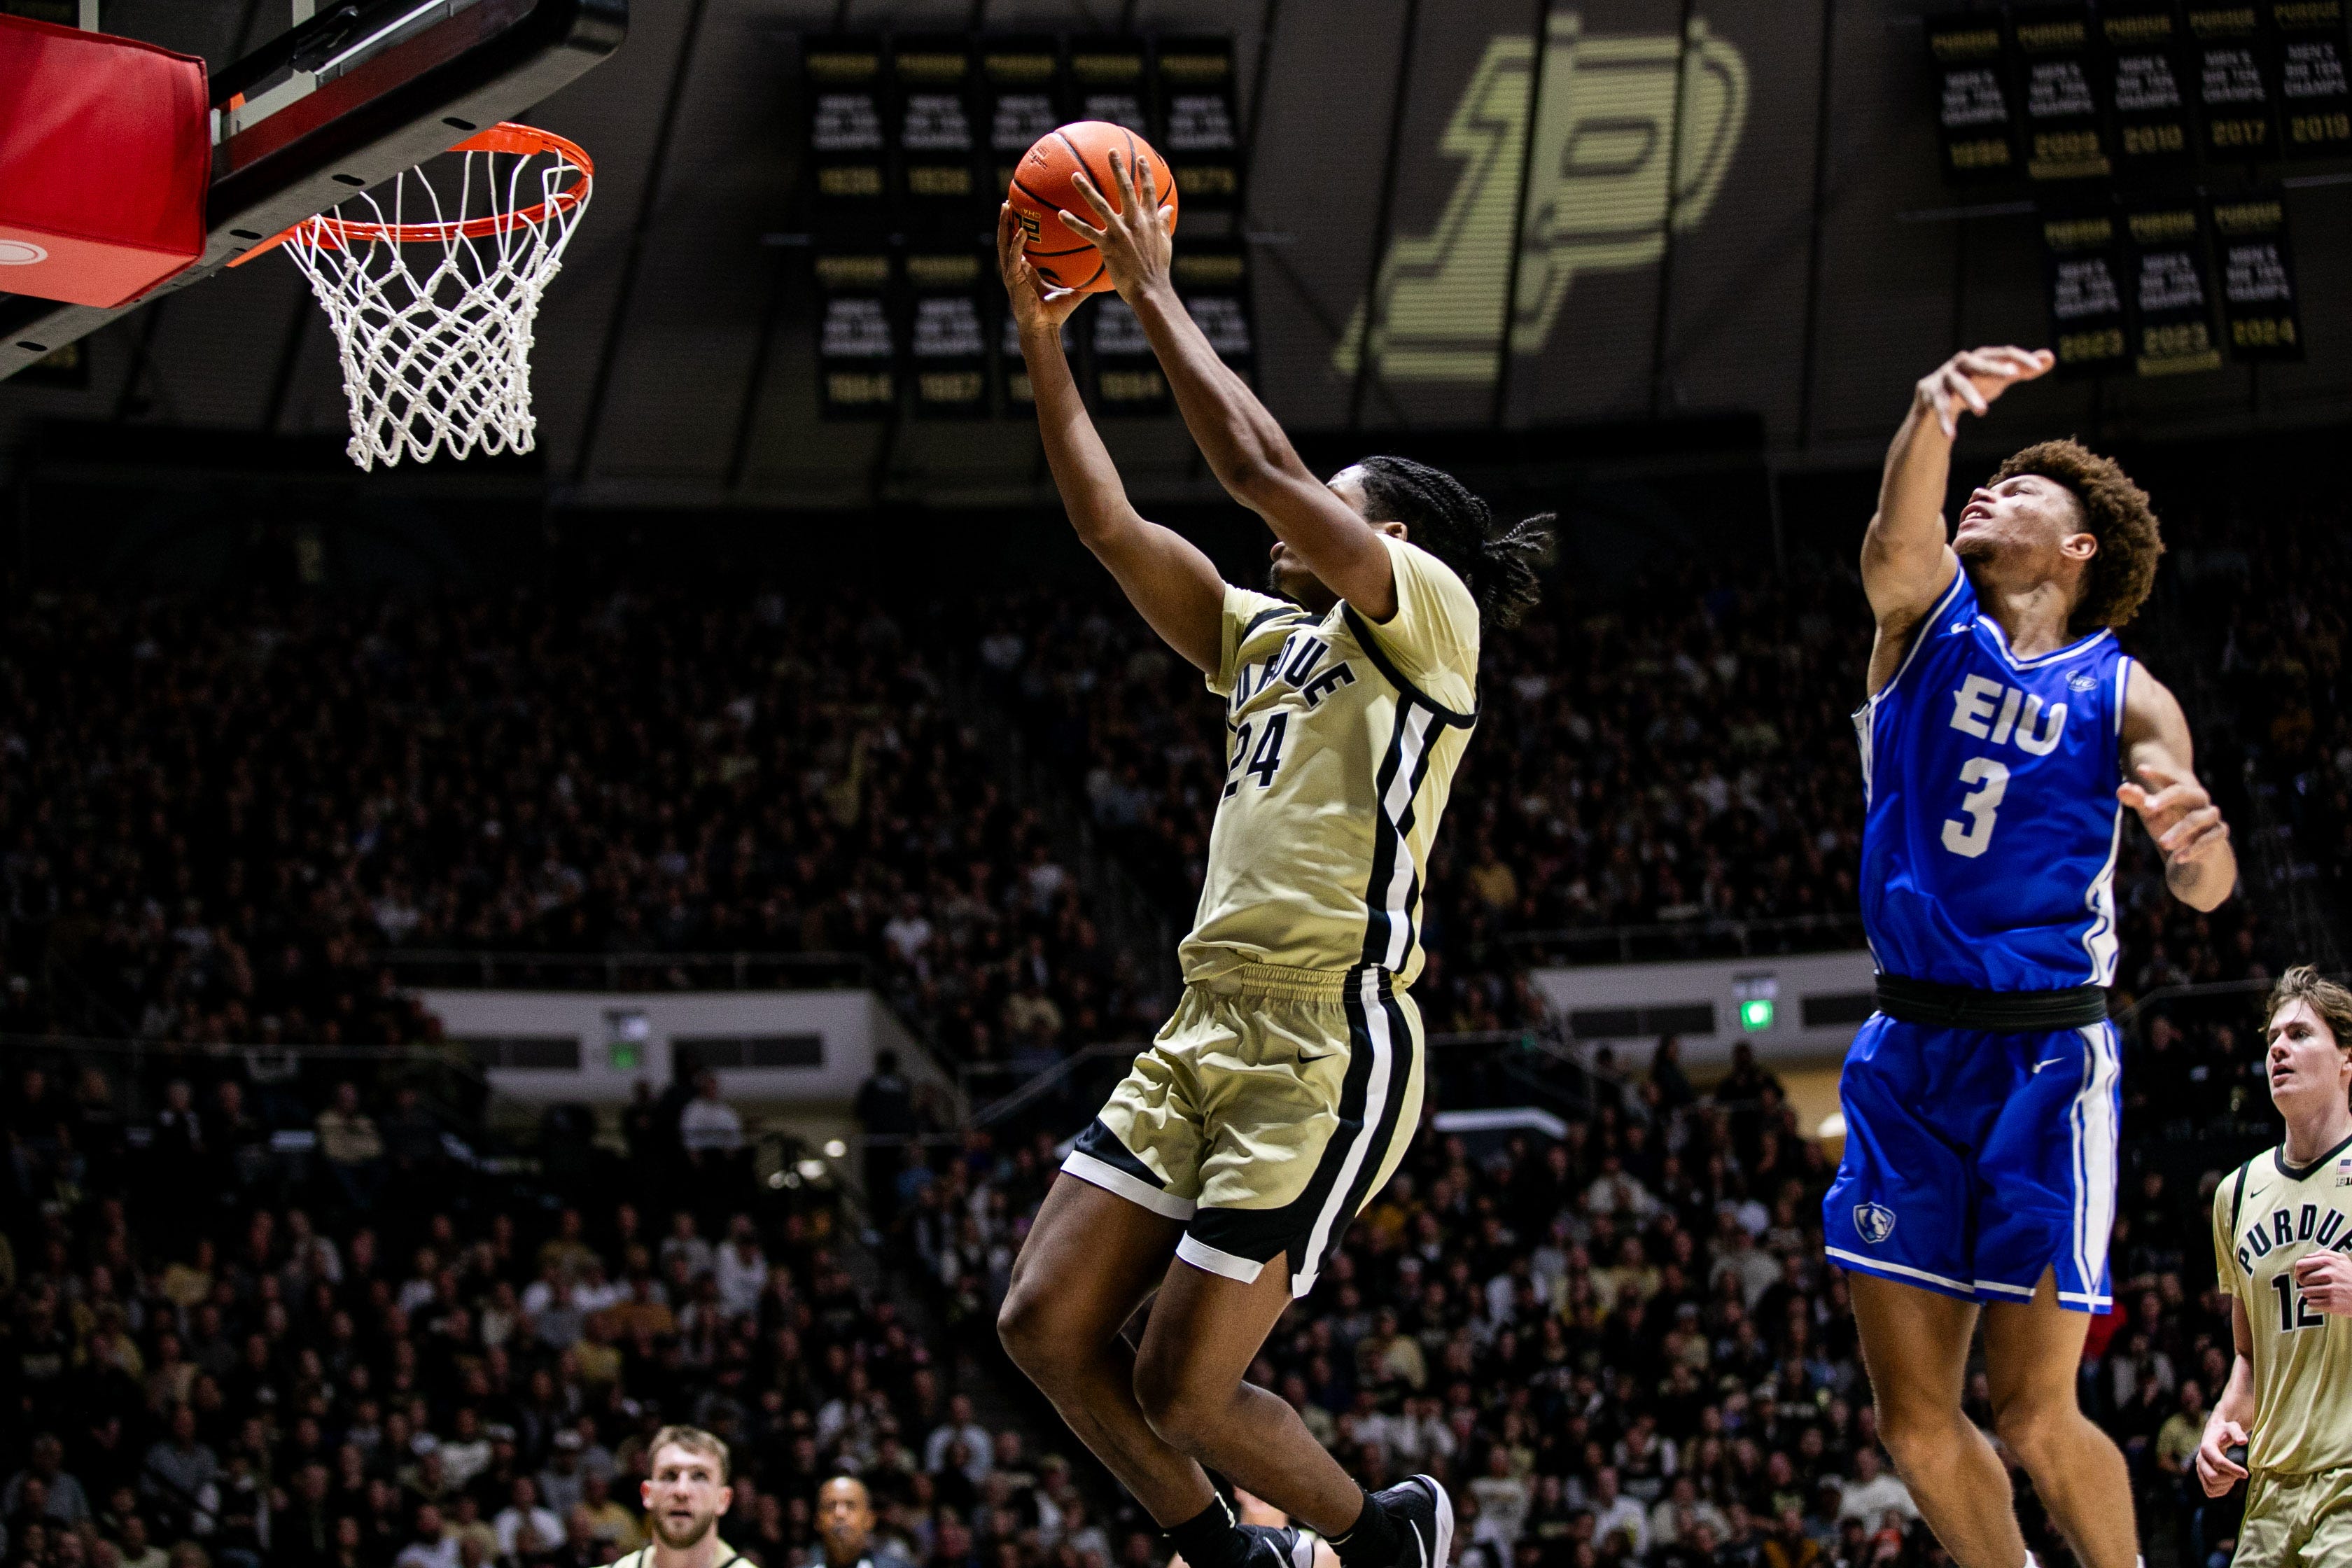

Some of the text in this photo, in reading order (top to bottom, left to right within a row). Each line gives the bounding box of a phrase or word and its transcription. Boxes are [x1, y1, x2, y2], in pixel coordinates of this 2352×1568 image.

[1226, 634, 1357, 715] URDUE
[1949, 673, 2068, 756] EIU
[1224, 712, 1289, 799] 24
[1941, 757, 2011, 858] 3
[2272, 1272, 2324, 1333] 12
